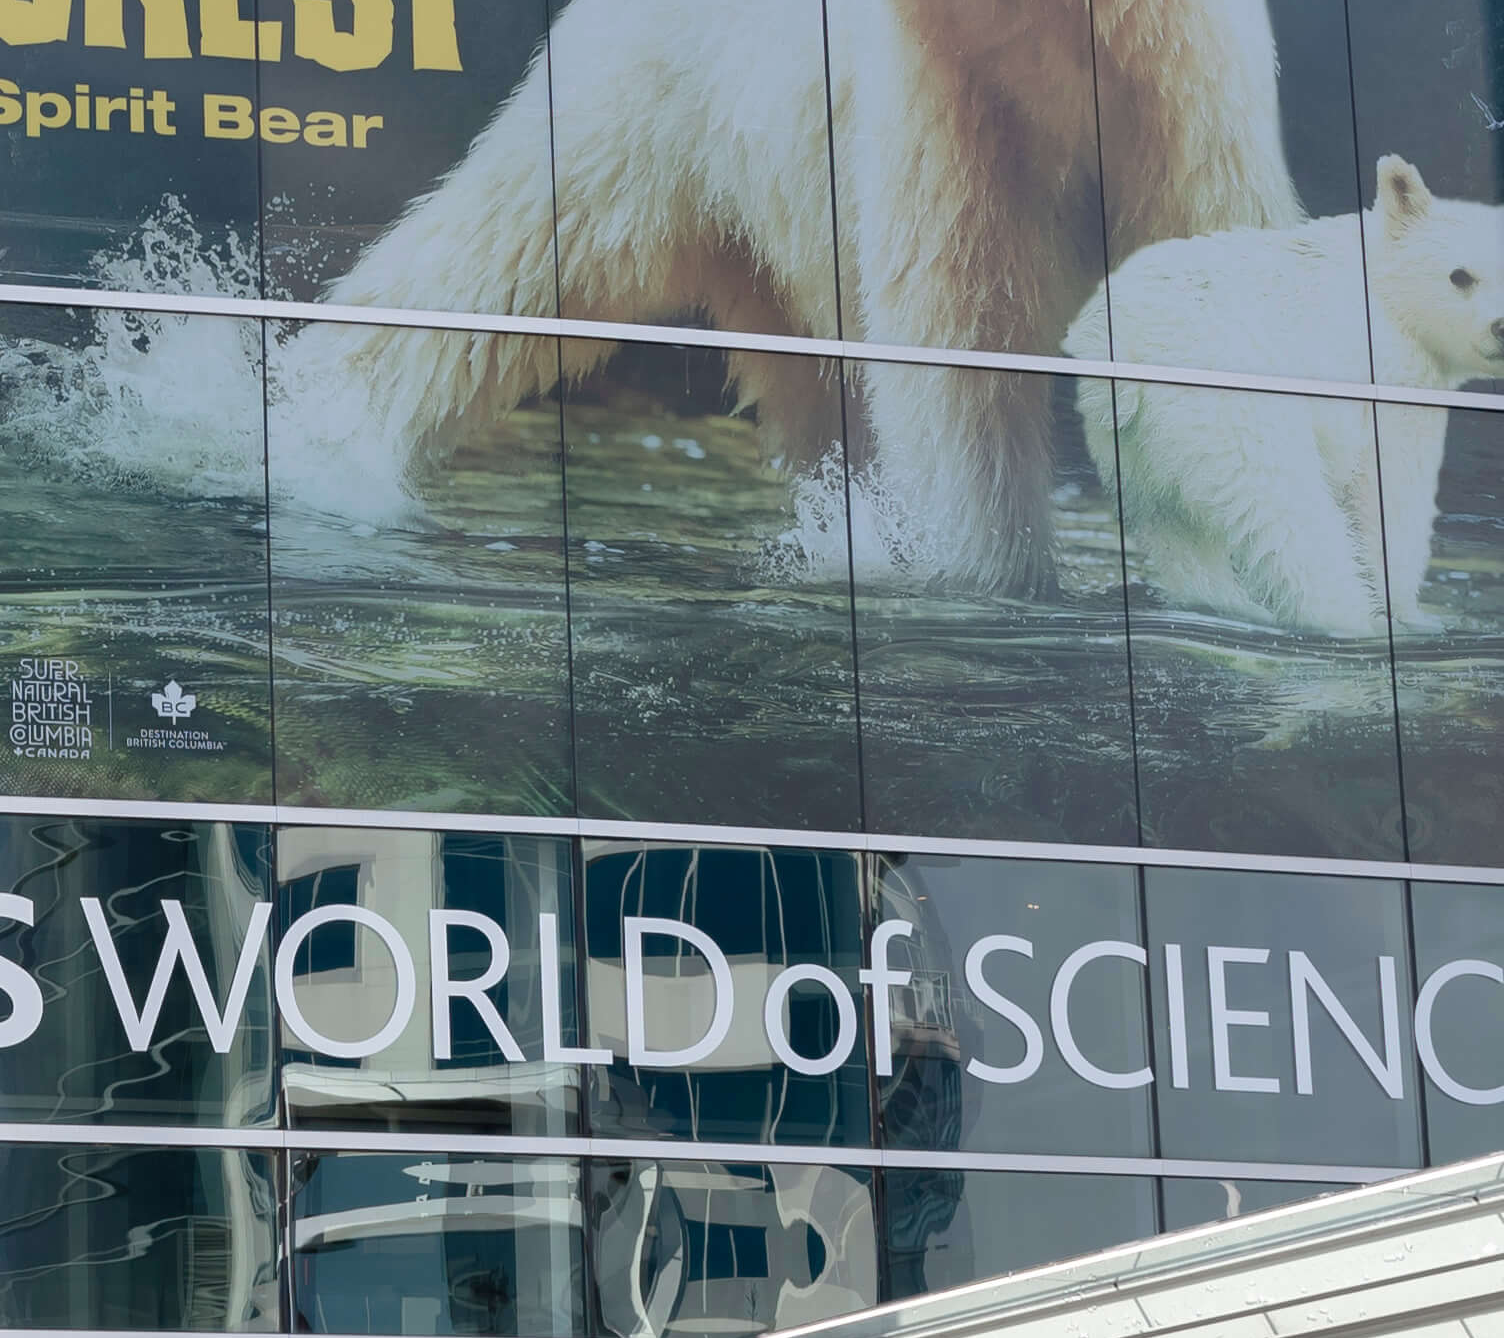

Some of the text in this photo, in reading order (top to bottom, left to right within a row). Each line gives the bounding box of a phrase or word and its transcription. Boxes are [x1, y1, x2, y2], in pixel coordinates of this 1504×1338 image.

[203, 93, 383, 150] Bear
[12, 680, 92, 704] NATURAL
[13, 702, 90, 725] BRITISH
[161, 701, 188, 714] BC
[9, 724, 92, 747] COLUMBIA
[127, 737, 166, 749] BRITISH
[141, 728, 209, 740] DESTINATION
[25, 748, 90, 759] CANADA
[80, 896, 734, 1067] WORLD
[763, 919, 914, 1078] of
